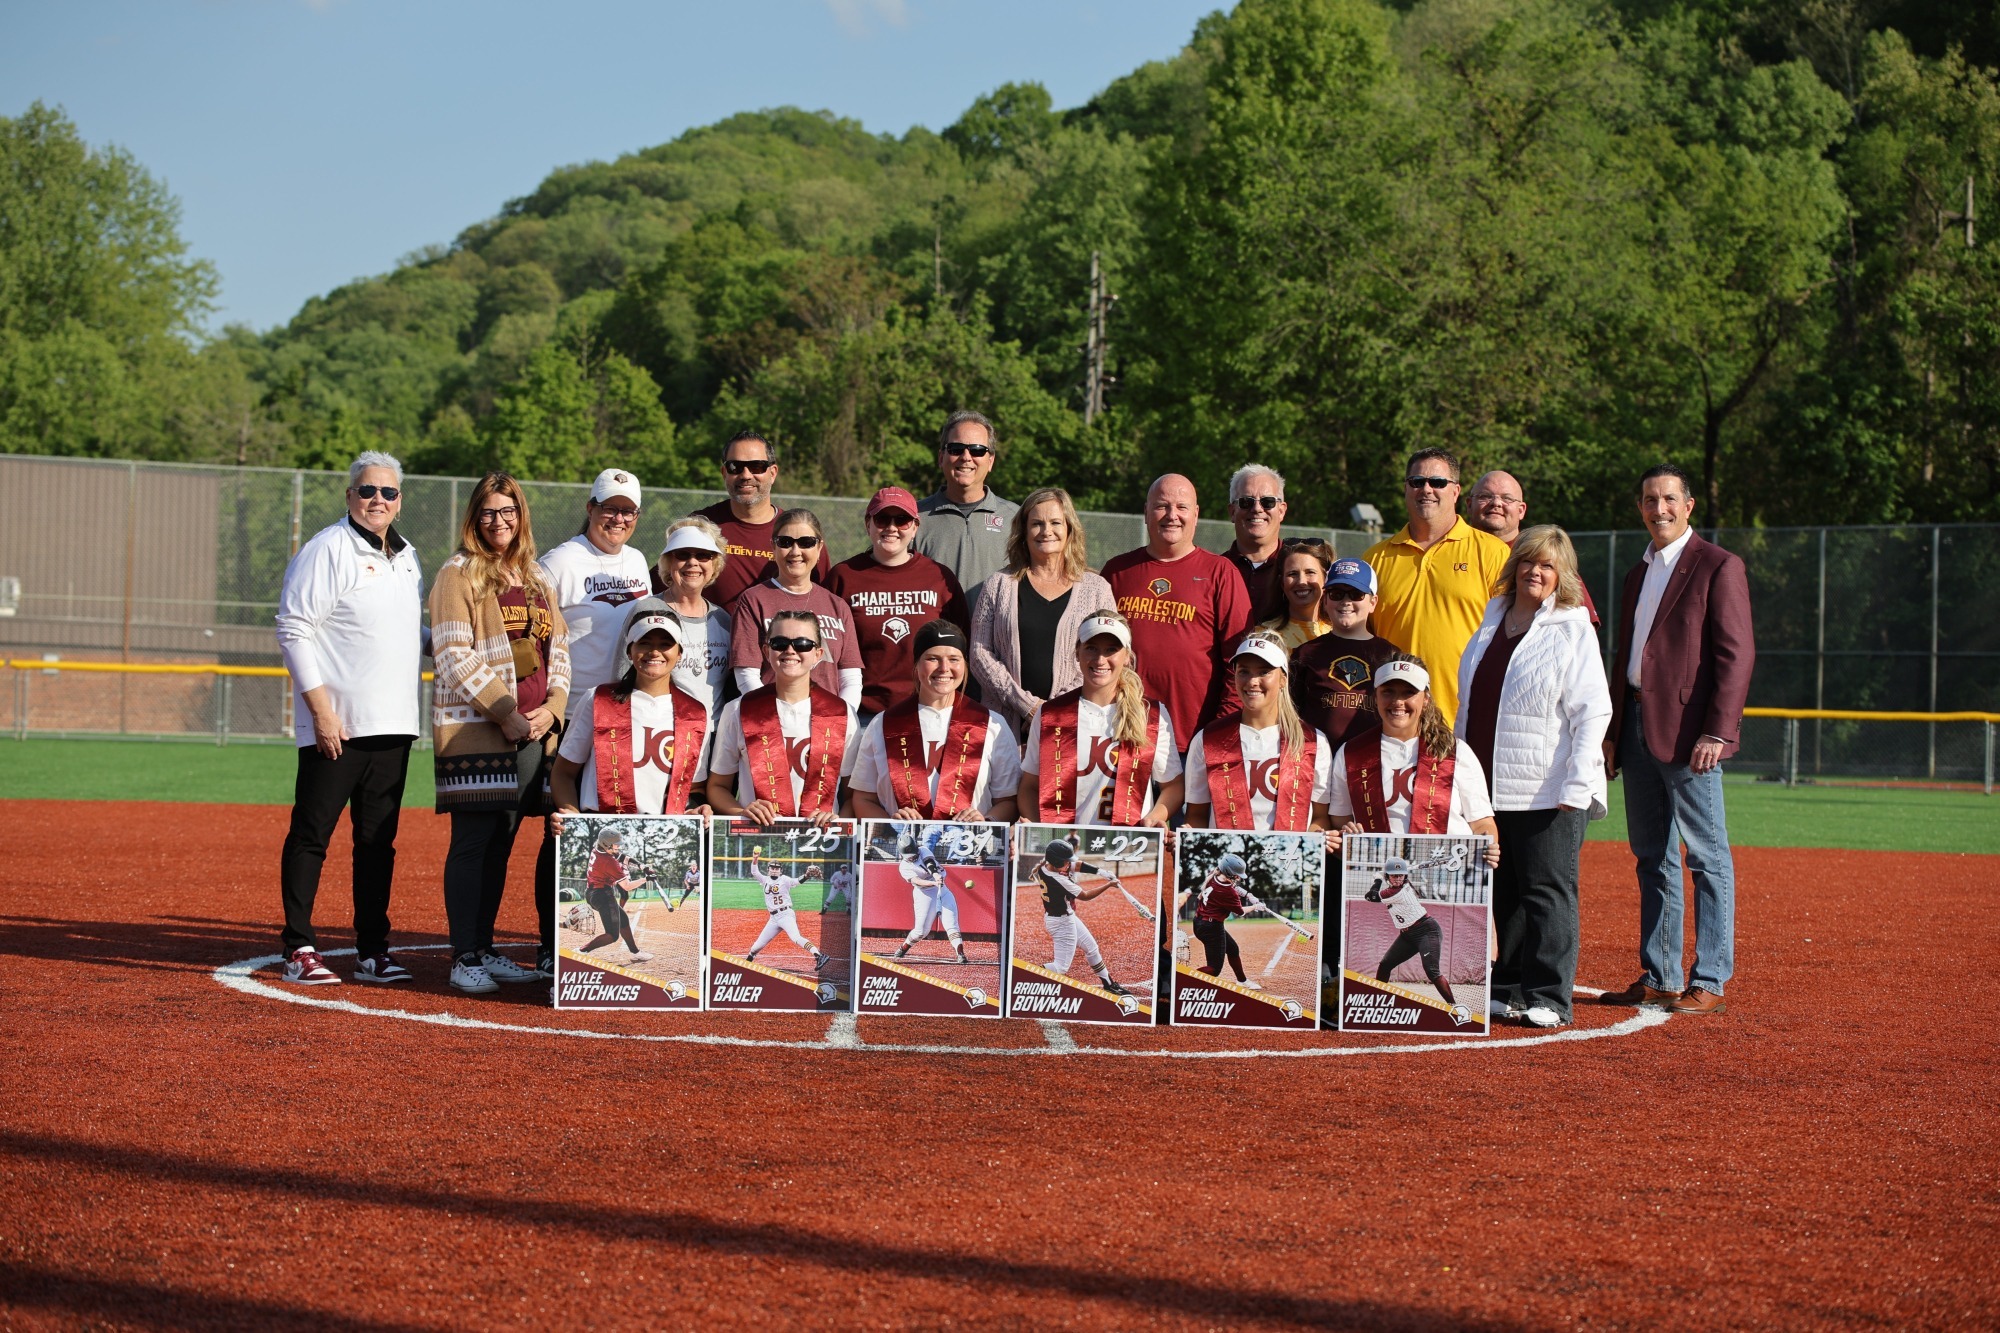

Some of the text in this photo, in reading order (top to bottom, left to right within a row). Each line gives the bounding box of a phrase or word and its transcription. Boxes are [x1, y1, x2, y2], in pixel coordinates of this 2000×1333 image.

[1453, 562, 1468, 572] UC
[584, 576, 646, 594] Charleston
[851, 590, 938, 607] CHARLESTON
[865, 604, 926, 616] SOFTBALL
[1117, 596, 1197, 622] CHARLESTON
[1127, 611, 1178, 625] SOFTBALL
[1320, 691, 1376, 713] SOFTBALL
[1125, 745, 1140, 823] THLETE
[784, 825, 843, 853] #25
[1090, 835, 1149, 863] #22
[1430, 843, 1468, 872] #8
[773, 895, 784, 905] 25
[560, 971, 605, 985] KAYLEE
[572, 953, 661, 987] CHARLESTON SOFTBALL
[713, 972, 743, 985] DANI
[723, 954, 814, 989] CHARLESTON SOFTBALL
[873, 958, 962, 993] CHARLESTON SOFTBALL
[862, 976, 898, 990] EMMA
[1012, 981, 1062, 996] BRIONNA
[1025, 963, 1114, 1000] CHARLESTON SOFTBALL
[1189, 969, 1278, 1005] CHARLESTON SOFTBALL
[559, 984, 641, 1001] HOTCHKISS
[712, 986, 763, 1003] BAUER
[862, 989, 903, 1007] GROE
[1178, 987, 1218, 1001] BEKAH
[1345, 993, 1396, 1007] MIKAYLA
[1357, 975, 1447, 1011] CHARLESTON SOFTBALL
[1012, 995, 1083, 1014] BOWMAN
[1180, 1001, 1236, 1019] WOODY
[1344, 1007, 1422, 1025] FERGUSON
